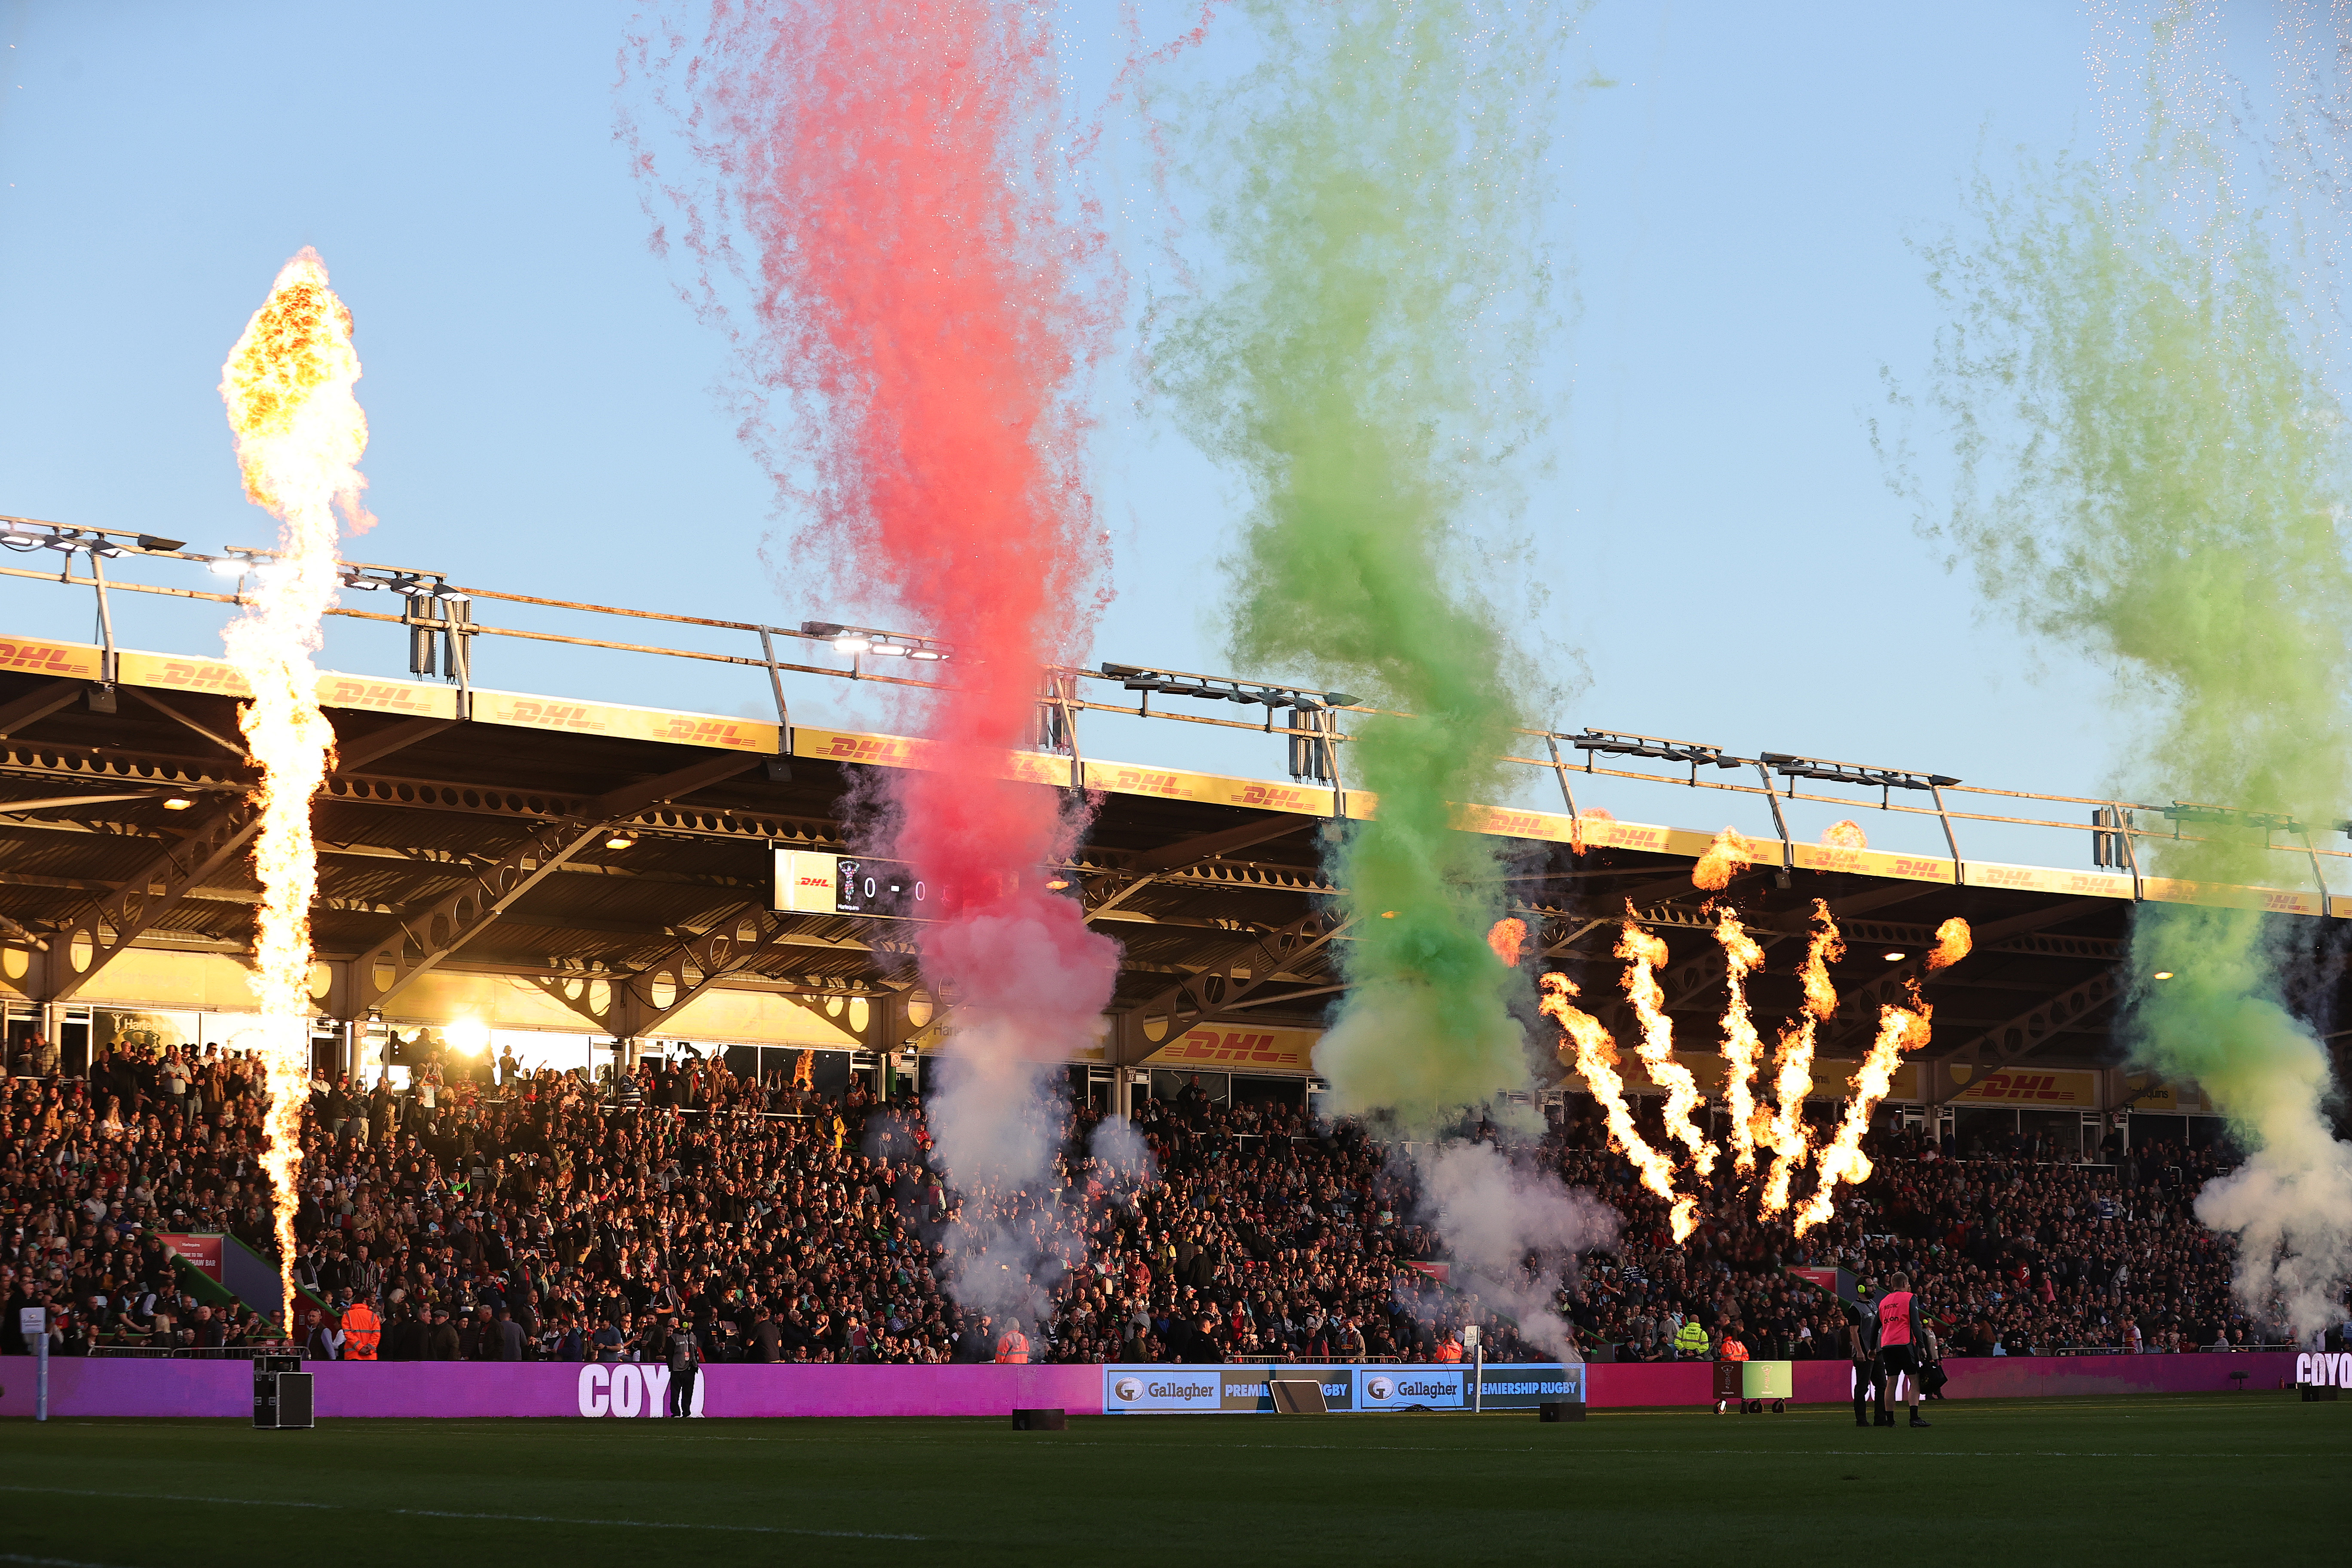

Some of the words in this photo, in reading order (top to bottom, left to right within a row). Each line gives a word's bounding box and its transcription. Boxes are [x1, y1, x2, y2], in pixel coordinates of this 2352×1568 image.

[162, 663, 247, 690] DHL
[333, 682, 419, 710] DHL
[511, 701, 591, 729] DHL
[667, 719, 742, 746] DHL
[829, 737, 901, 763] DHL
[1117, 771, 1181, 794] DHL
[1242, 786, 1304, 809] DHL
[1489, 813, 1544, 836] DHL
[1607, 827, 1660, 848] DHL
[1895, 859, 1940, 879] DHL
[1986, 869, 2034, 888] DHL
[800, 877, 829, 888] DHL
[864, 877, 876, 898] 0
[915, 881, 926, 901] 0
[2070, 876, 2118, 894] DHL
[1182, 1030, 1280, 1062] DHL
[1981, 1074, 2060, 1100] DHL
[1148, 1382, 1214, 1401] Gallagher
[1225, 1384, 1270, 1397] PREMIE
[1320, 1384, 1348, 1396] GBY
[1398, 1381, 1457, 1400] Gallagher
[1467, 1382, 1540, 1395] PEMIERSHIP
[1540, 1381, 1577, 1394] RUGBY
